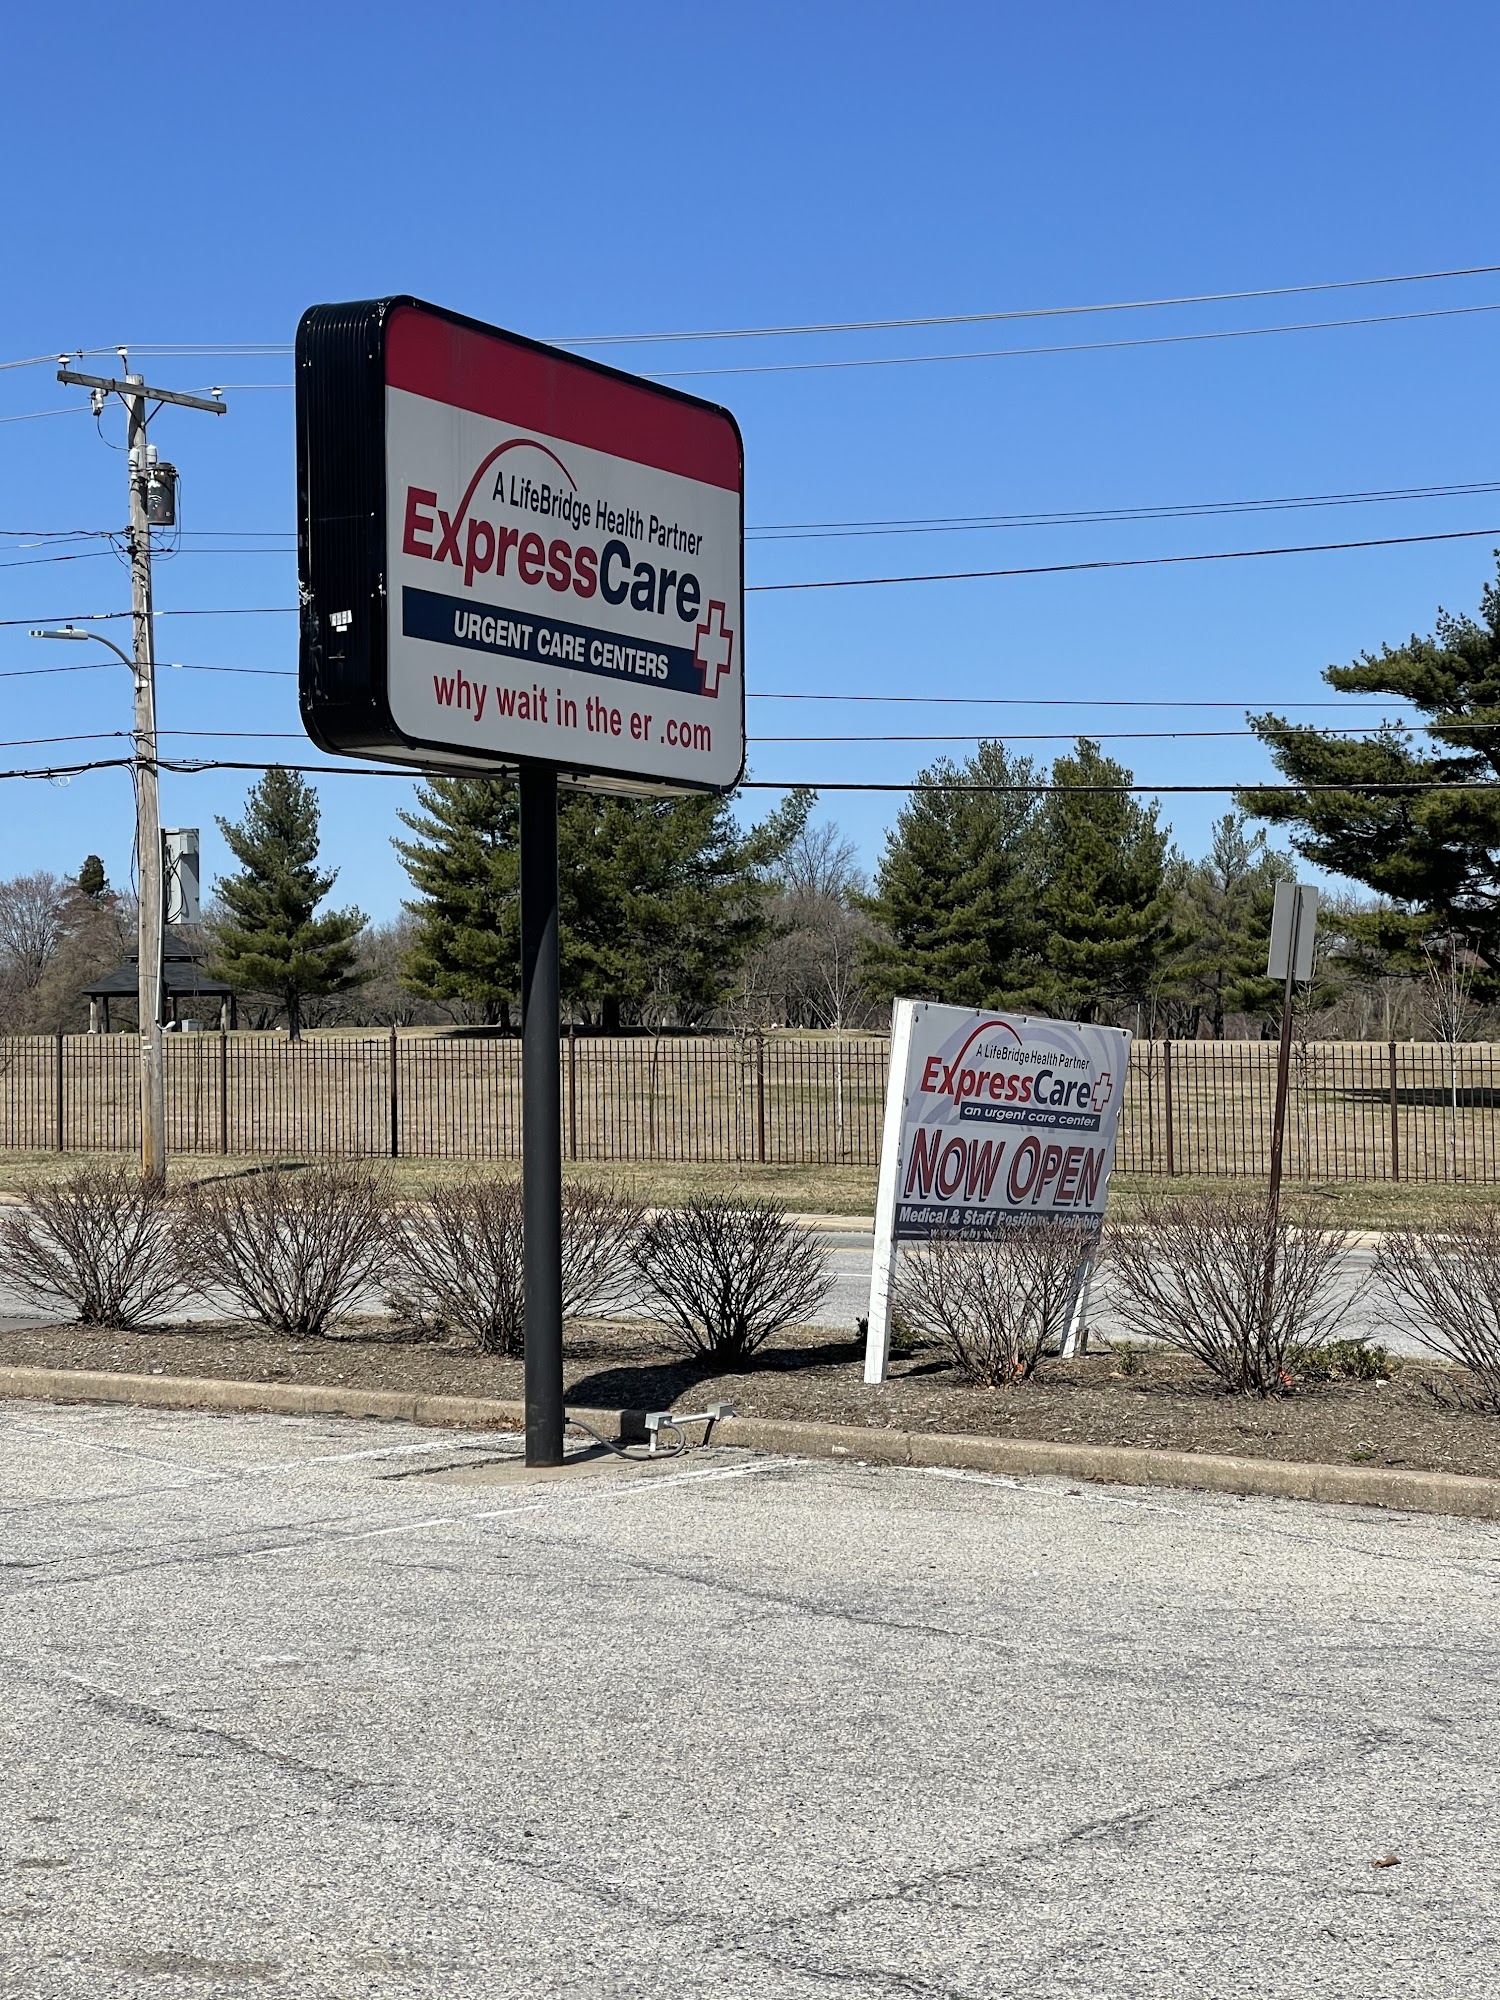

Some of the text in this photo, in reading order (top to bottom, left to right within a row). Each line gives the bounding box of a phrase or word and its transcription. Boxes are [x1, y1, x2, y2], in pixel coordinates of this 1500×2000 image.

[493, 471, 703, 555] A LifeBridge Health Partner
[403, 485, 701, 623] ExpressCare
[454, 610, 669, 680] URGENT CARE CENTERS
[433, 669, 711, 752] why wait in the er .com
[920, 1056, 1092, 1109] ExpressCare
[975, 1043, 1090, 1070] A LifeBridge Health Partner
[964, 1106, 1096, 1127] an urgent care center
[904, 1128, 1106, 1207] NOW OPEN
[899, 1206, 948, 1224] Medical
[950, 1208, 962, 1224] &
[963, 1209, 997, 1226] Staff
